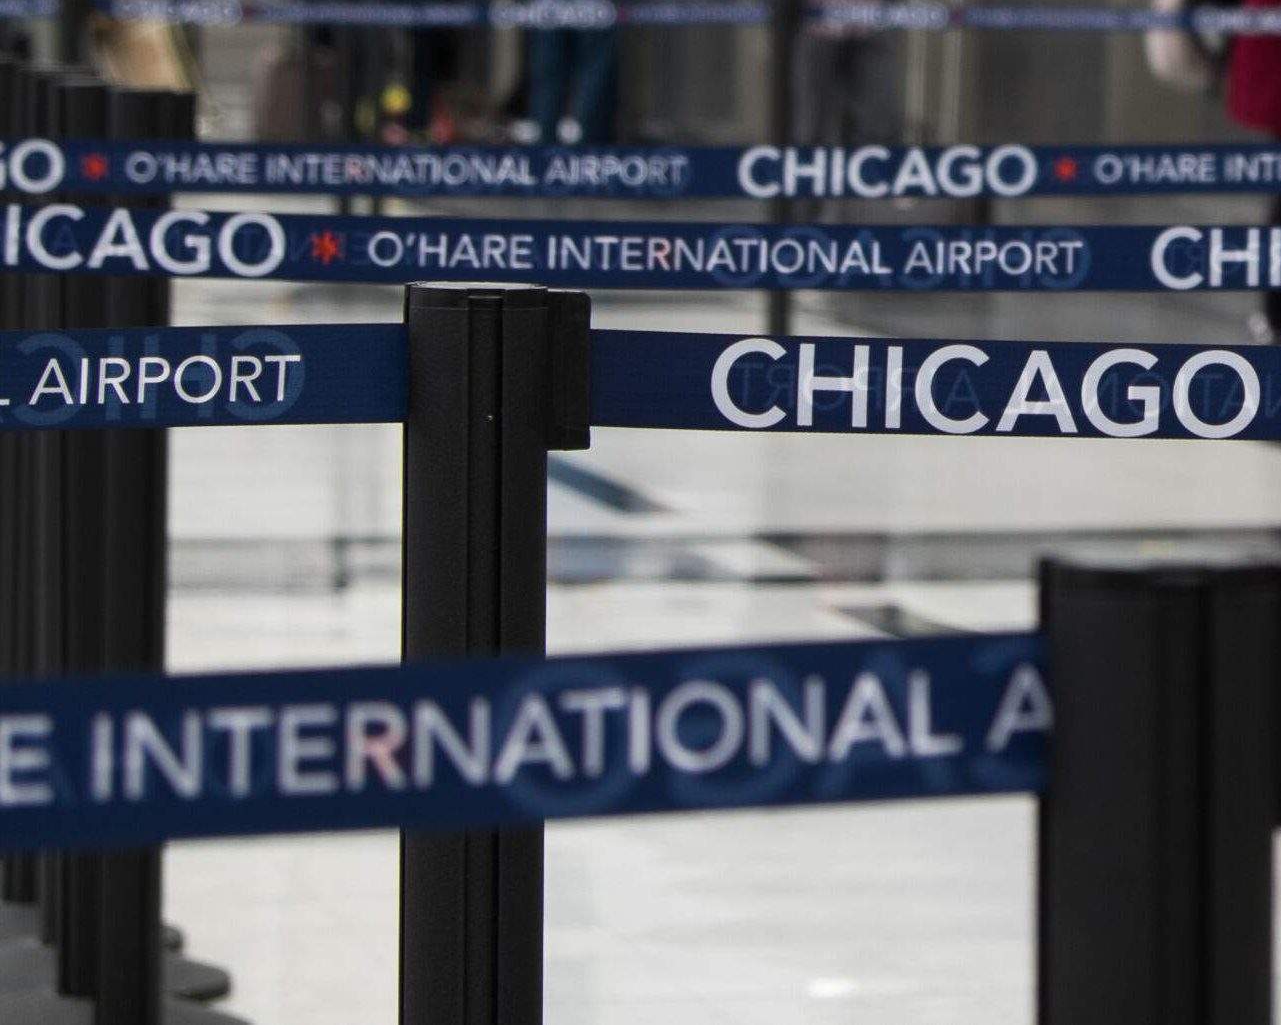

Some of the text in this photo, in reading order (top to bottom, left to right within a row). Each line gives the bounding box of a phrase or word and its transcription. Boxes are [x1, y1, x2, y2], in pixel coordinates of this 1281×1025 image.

[0, 139, 690, 195] O O'HARE INTERNATIONAL AIRPORT
[738, 145, 1037, 198] CHICAGO
[1095, 153, 1216, 185] O'HARE
[4, 203, 286, 277] ICAGO
[367, 230, 534, 270] O'HARE
[547, 235, 893, 276] INTERNATIONAL
[904, 240, 1085, 276] AIRPORT
[28, 354, 302, 406] AIRPORT
[710, 337, 1260, 439] CHICAGO
[0, 713, 54, 807] E
[91, 665, 963, 804] INTERNATIONAL
